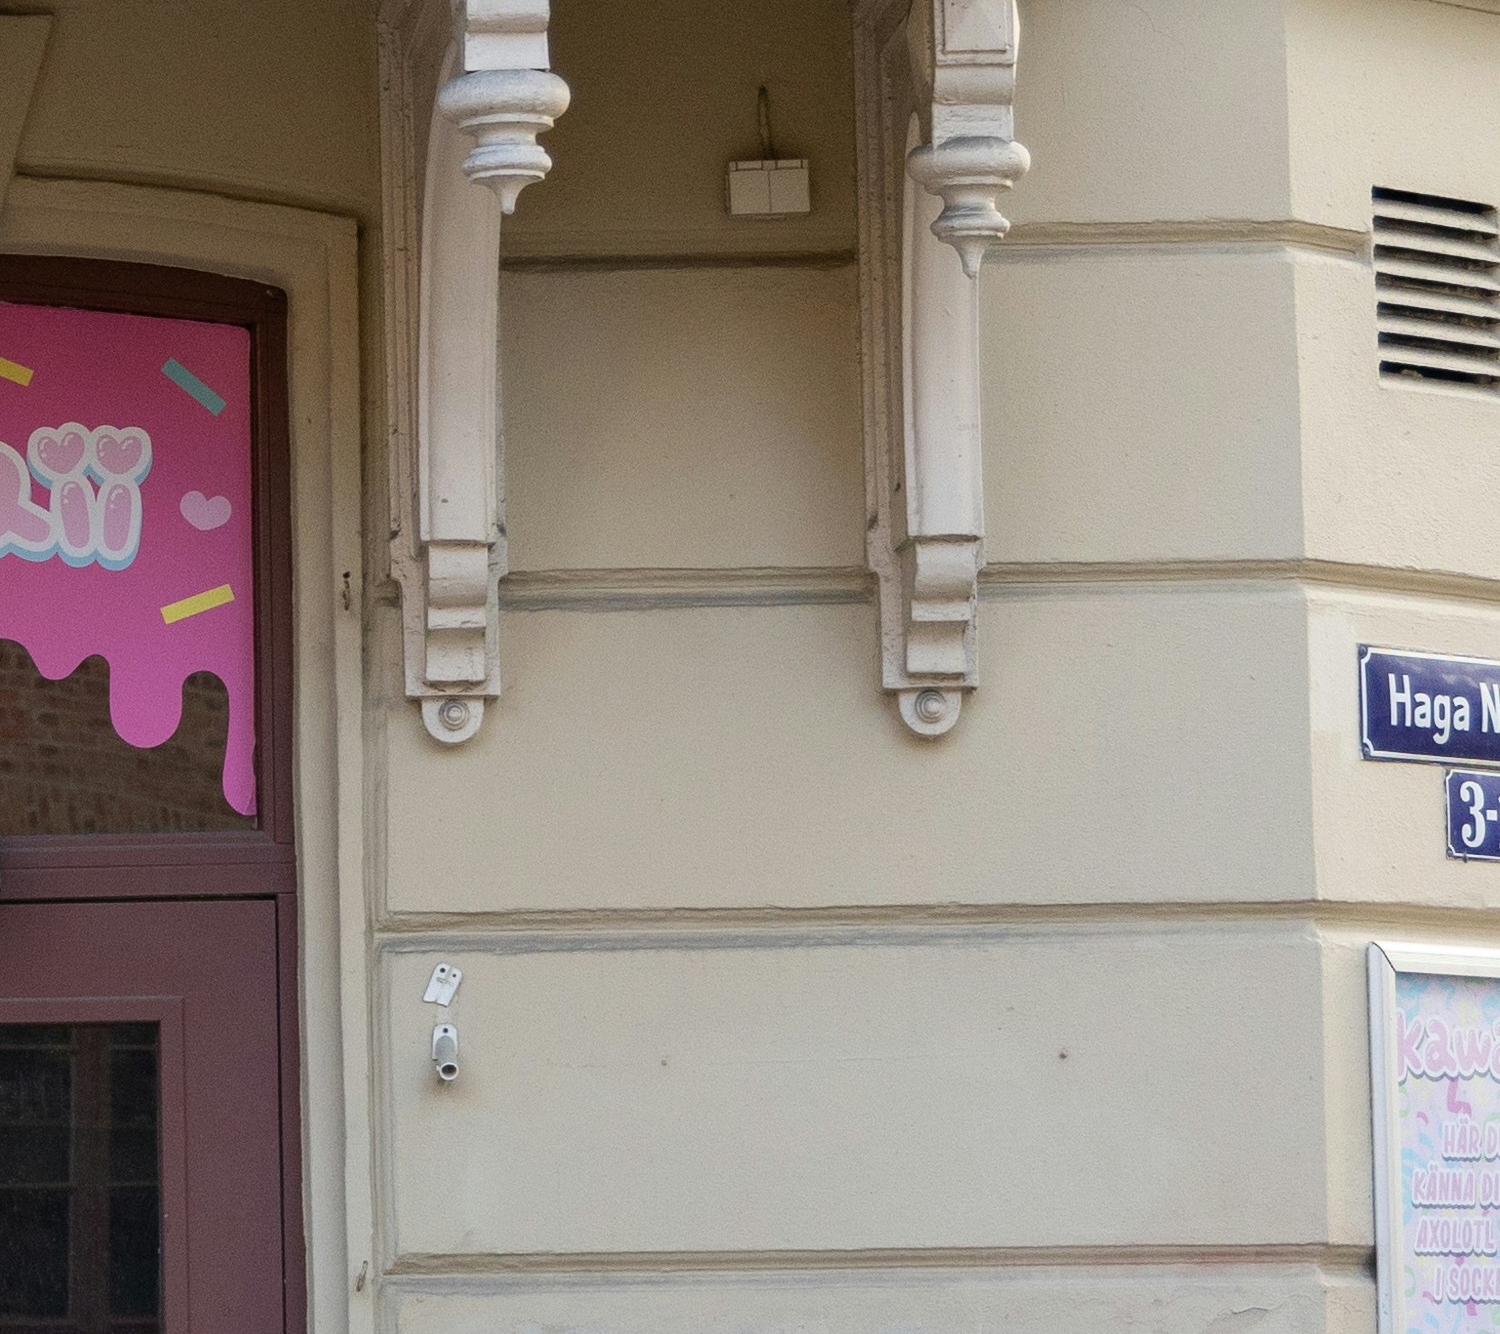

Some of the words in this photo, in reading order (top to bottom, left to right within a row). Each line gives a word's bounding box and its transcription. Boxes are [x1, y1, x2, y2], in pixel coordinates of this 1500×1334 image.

[1387, 671, 1470, 745] Haga
[1442, 1115, 1481, 1161] HÄR
[1412, 1163, 1476, 1208] KÄNNA
[1414, 1218, 1497, 1256] AXOLOTL
[1434, 1266, 1443, 1304] I
